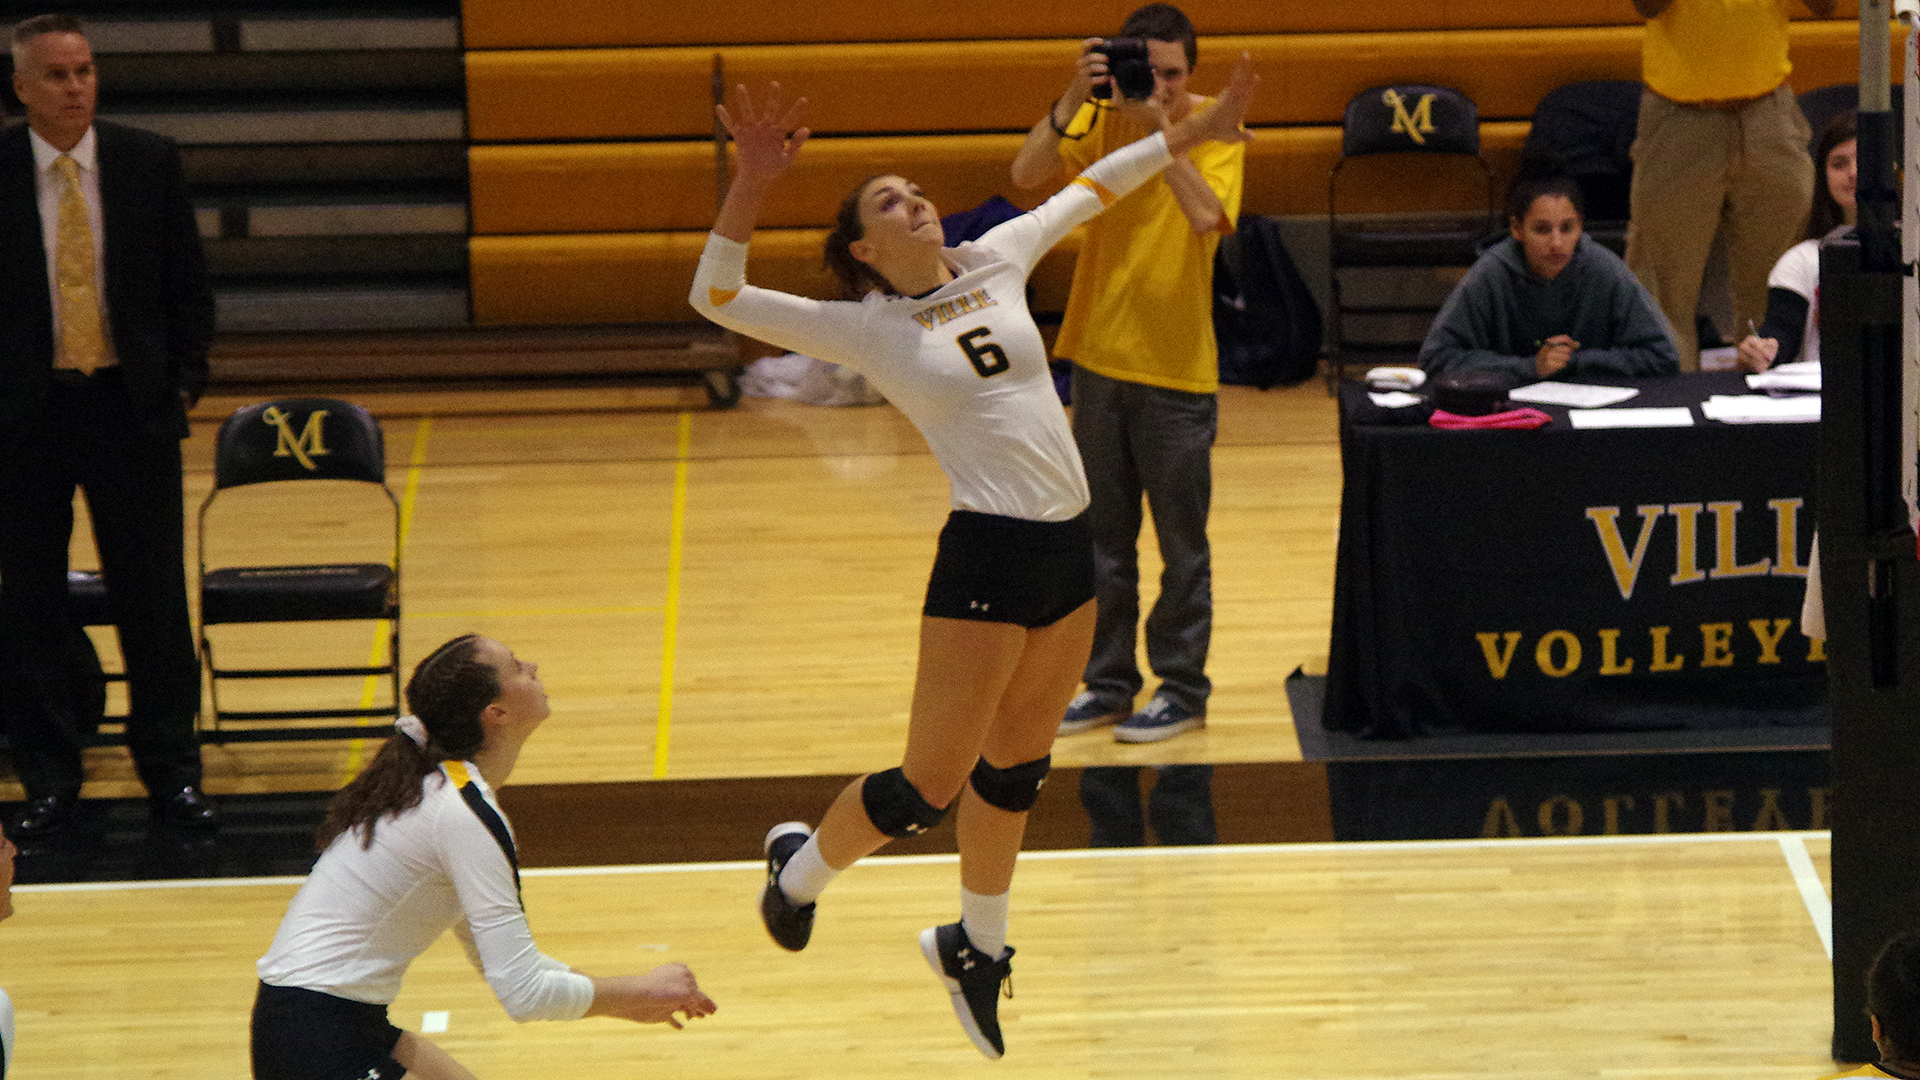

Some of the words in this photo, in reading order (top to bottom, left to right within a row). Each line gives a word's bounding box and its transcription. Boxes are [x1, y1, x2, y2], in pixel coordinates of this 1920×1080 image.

[1381, 88, 1437, 145] M
[912, 288, 998, 331] VILLE
[955, 324, 1011, 380] 6
[262, 405, 331, 471] M
